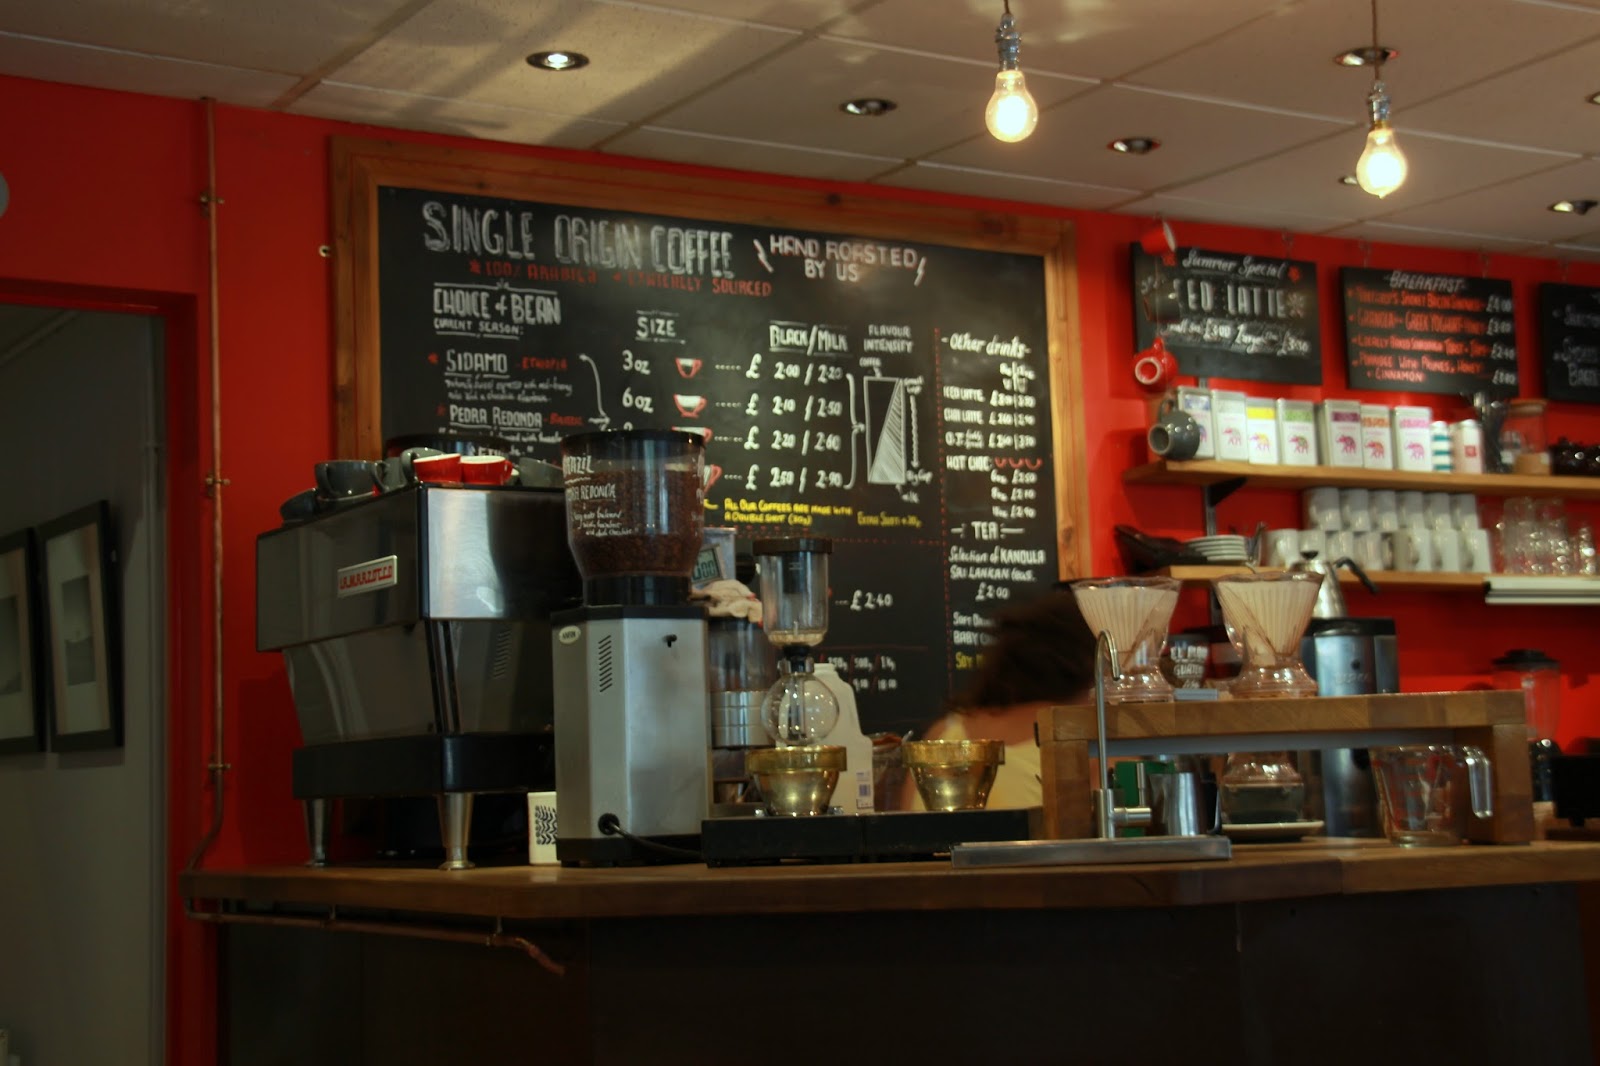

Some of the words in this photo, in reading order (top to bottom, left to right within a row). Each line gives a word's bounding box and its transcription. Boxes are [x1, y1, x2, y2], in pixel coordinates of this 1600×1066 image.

[422, 201, 535, 260] SINGLE
[554, 215, 642, 270] ORIGIN
[651, 225, 735, 279] COFFEE
[770, 234, 820, 258] HAND
[826, 240, 918, 268] ROASTED
[804, 258, 826, 279] BY
[836, 263, 860, 282] US
[1182, 249, 1237, 272] Summer
[1238, 255, 1287, 279] Special
[527, 263, 597, 283] ARABICA
[711, 277, 773, 297] SOURCED
[1390, 270, 1464, 293] BREAKFAST
[434, 288, 491, 319] CHOICE
[510, 293, 562, 325] BEAN
[636, 316, 677, 338] SIZE
[868, 324, 911, 338] FLAVOUR
[446, 349, 508, 373] SIDAMO
[622, 349, 651, 375] 3oz
[1375, 367, 1426, 383] CINNAMON
[622, 387, 654, 414] 6oz
[449, 404, 487, 424] PEDRA
[492, 406, 543, 428] REDONDA
[971, 521, 999, 540] TEA
[953, 630, 978, 646] BABY
